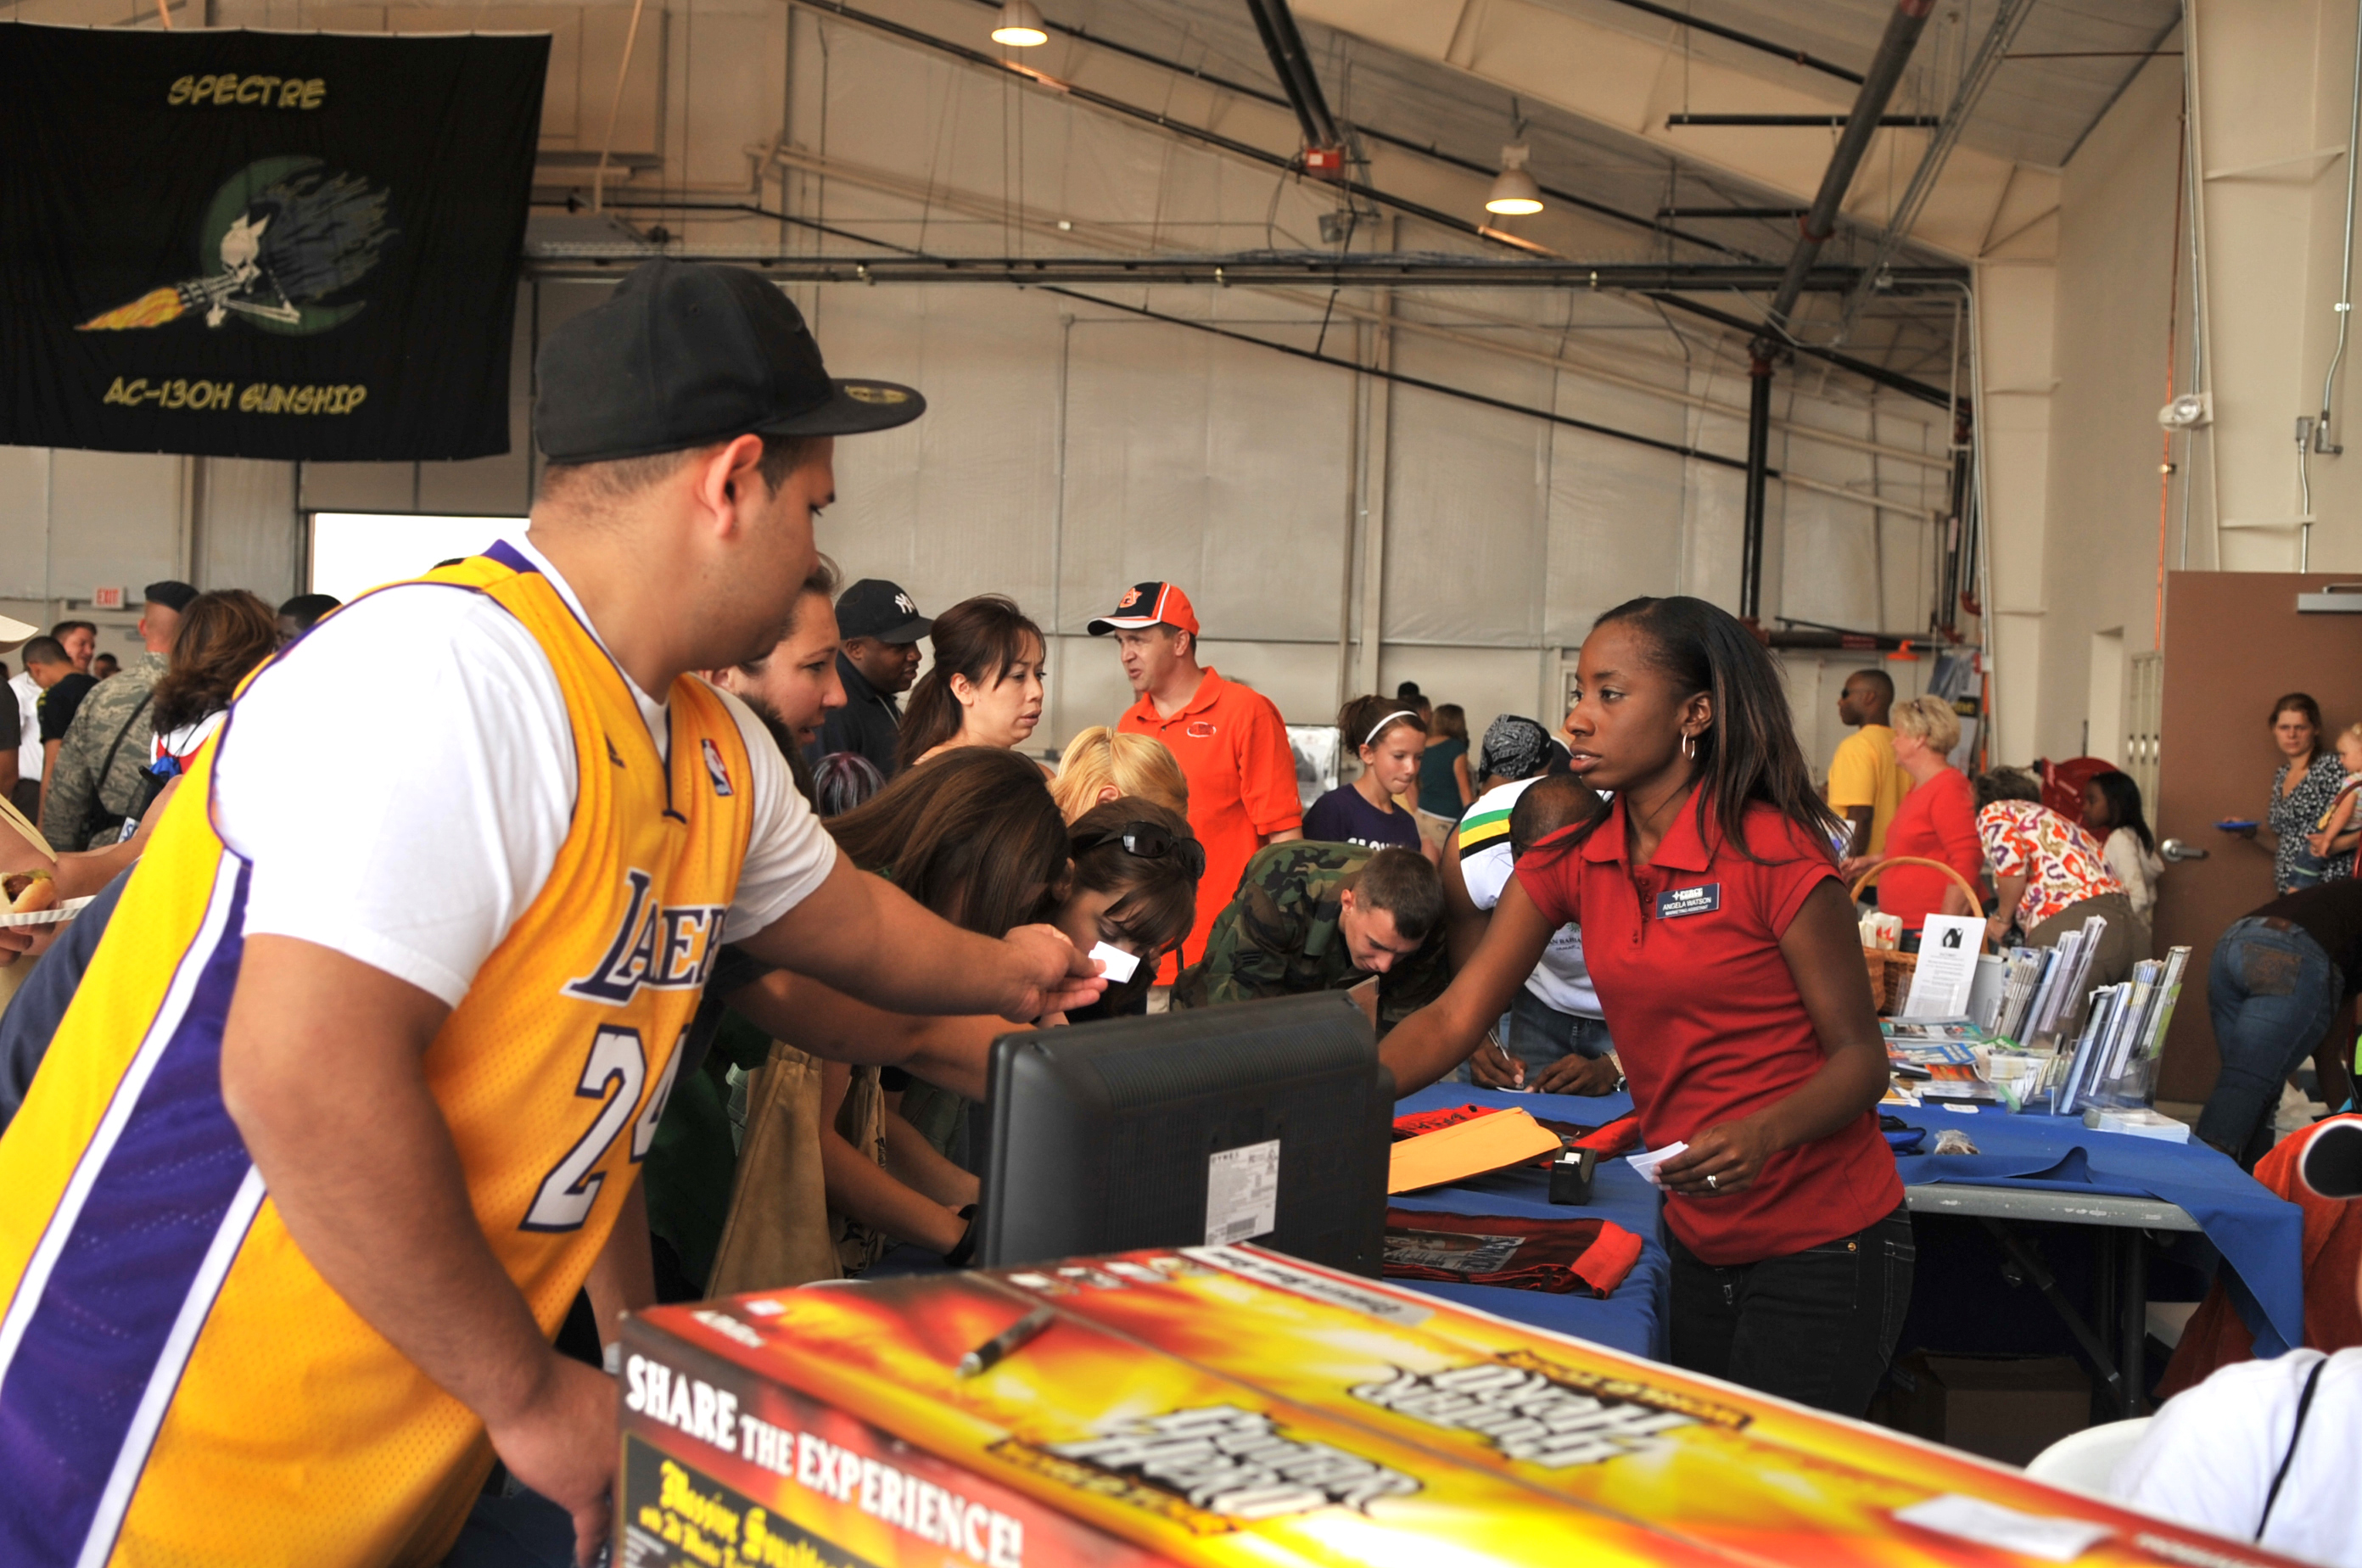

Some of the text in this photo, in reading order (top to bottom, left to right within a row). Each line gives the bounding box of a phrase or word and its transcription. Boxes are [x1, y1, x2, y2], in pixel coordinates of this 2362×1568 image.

[167, 73, 327, 110] SPECTRE
[103, 376, 368, 415] AC-130H GUNSHIP
[96, 587, 120, 607] EXIT
[1662, 897, 1712, 910] ANGELA WATSON
[625, 1354, 738, 1453] SHARE
[739, 1414, 794, 1478] THE
[796, 1431, 1023, 1568] EXPERIENCE!
